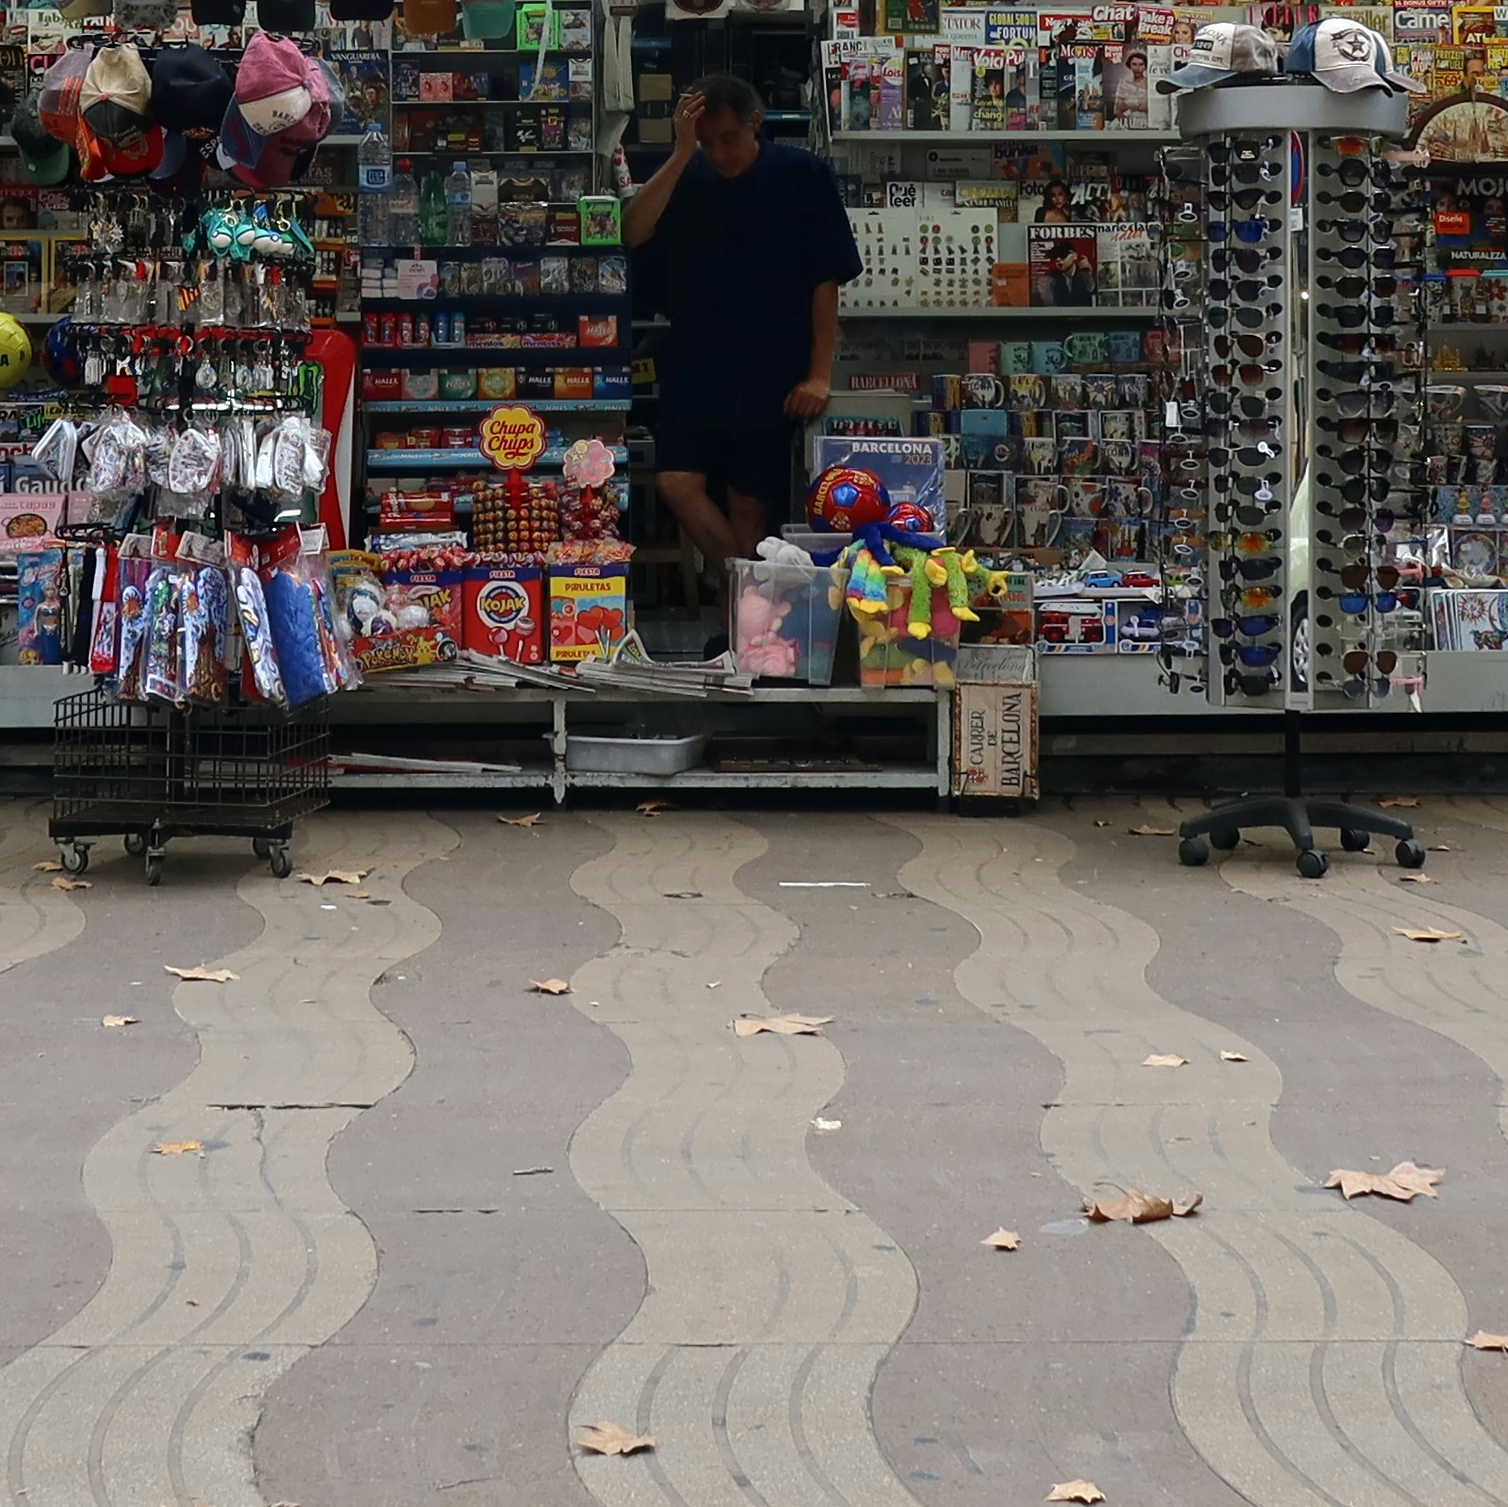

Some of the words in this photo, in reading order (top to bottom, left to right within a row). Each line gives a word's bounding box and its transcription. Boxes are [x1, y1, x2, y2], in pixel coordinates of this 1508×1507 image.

[1093, 5, 1135, 23] Chat
[1138, 21, 1174, 35] Break
[889, 181, 917, 196] Qué
[1030, 226, 1095, 240] FORBES
[1451, 250, 1507, 261] NATURALEZA
[489, 421, 536, 437] Chupa
[488, 435, 535, 459] Chups
[851, 442, 933, 454] BARCELONA
[906, 455, 933, 465] 2023
[565, 582, 612, 593] PIRULETAS
[480, 596, 527, 614] KOJAK
[968, 710, 986, 765] CARRER
[987, 731, 998, 747] DE
[1001, 693, 1023, 788] BARCELONA
